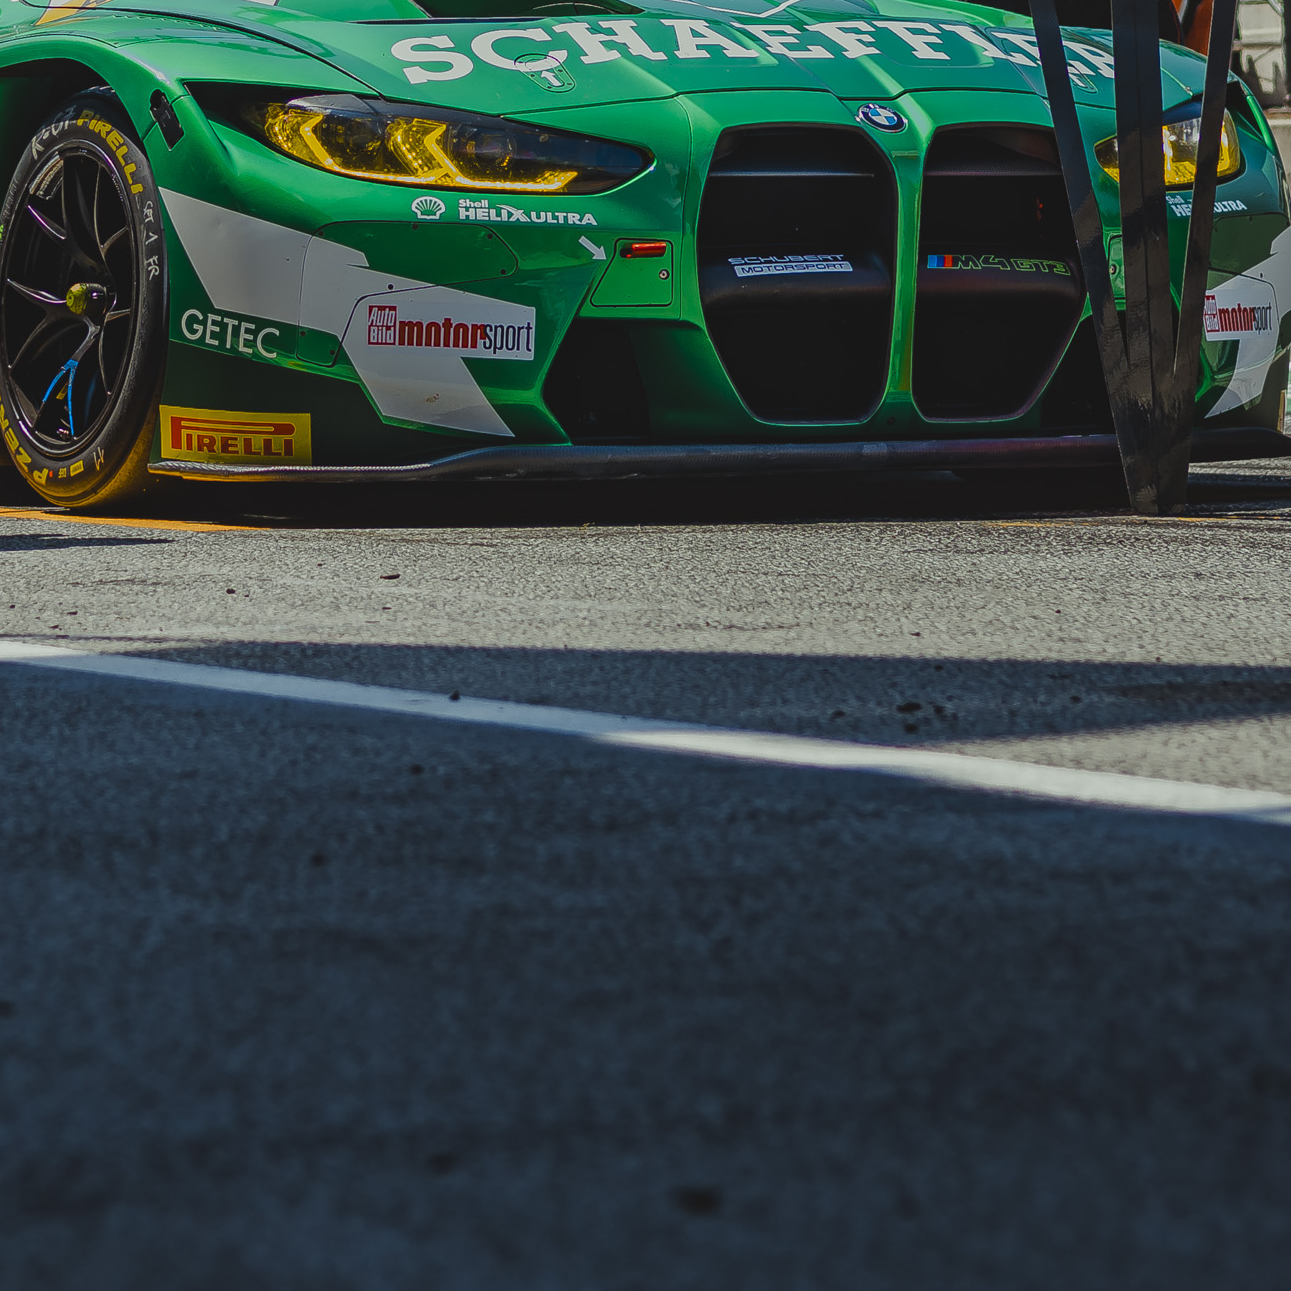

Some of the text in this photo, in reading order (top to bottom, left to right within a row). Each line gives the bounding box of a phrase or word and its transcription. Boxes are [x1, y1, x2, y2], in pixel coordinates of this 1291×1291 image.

[76, 111, 144, 194] PIRELLI
[458, 198, 489, 208] Shell
[458, 205, 598, 226] HELIX ULTRA
[728, 254, 845, 264] SCHUBERT
[740, 262, 846, 273] MOTORSPORT
[1011, 259, 1071, 276] GT3
[368, 307, 395, 327] Auto
[1218, 302, 1272, 335] motorsport
[181, 309, 280, 358] GETEC
[370, 325, 394, 344] Bild
[398, 317, 533, 355] motorsport
[170, 416, 296, 456] PIRELLI
